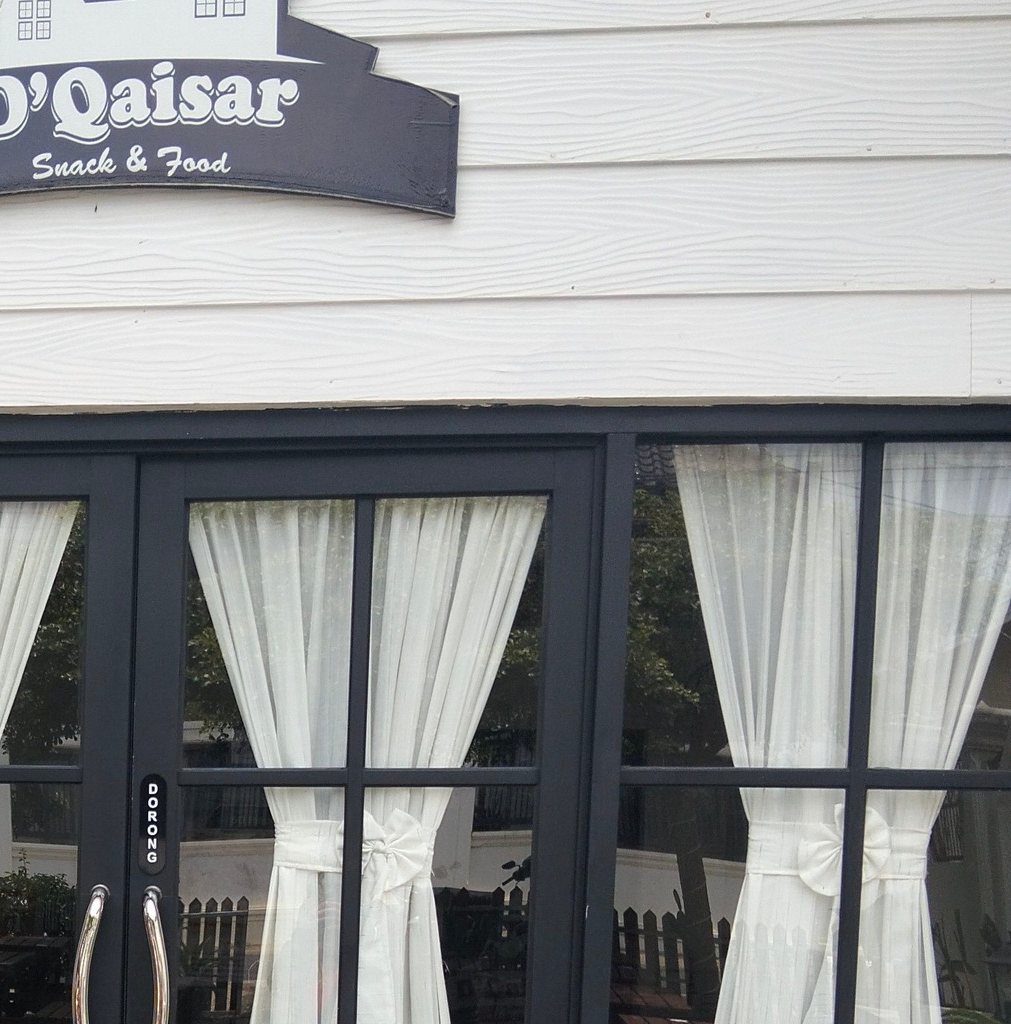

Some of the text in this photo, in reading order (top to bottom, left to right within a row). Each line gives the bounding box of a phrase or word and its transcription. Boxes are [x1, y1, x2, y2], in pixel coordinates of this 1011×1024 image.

[32, 144, 231, 180] Snack & Food
[146, 783, 159, 863] DORONG
